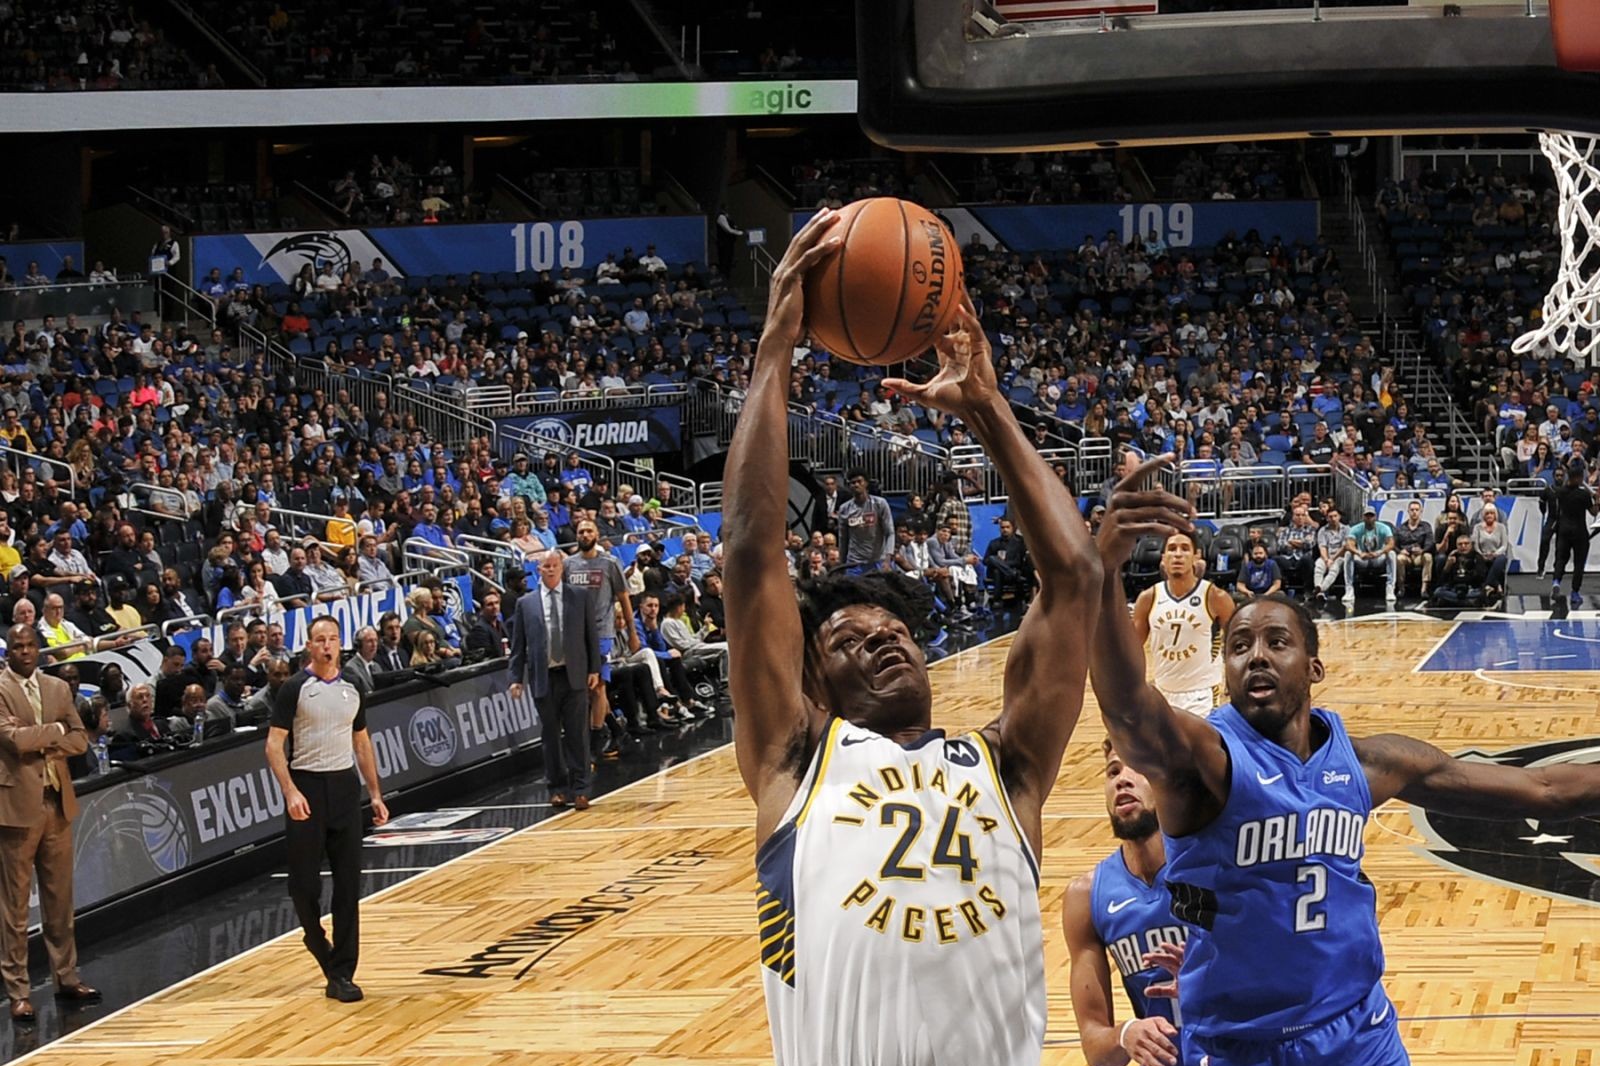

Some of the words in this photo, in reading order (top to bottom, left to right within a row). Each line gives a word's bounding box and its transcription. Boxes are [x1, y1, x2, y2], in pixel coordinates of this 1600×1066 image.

[511, 220, 584, 273] 108
[1118, 203, 1193, 247] 109
[575, 420, 649, 448] FLORIDA
[1152, 608, 1202, 631] INDIANA
[1170, 622, 1182, 647] 7
[1157, 642, 1198, 662] PACERS
[423, 741, 450, 757] SPORTS
[190, 767, 286, 844] EXCLU
[416, 716, 448, 745] FOX
[832, 762, 999, 835] INDIANA
[1321, 770, 1351, 786] Disney
[878, 801, 981, 886] 24
[1235, 807, 1366, 869] ORLANDO
[840, 878, 1009, 945] PACERS
[1294, 863, 1329, 934] 2
